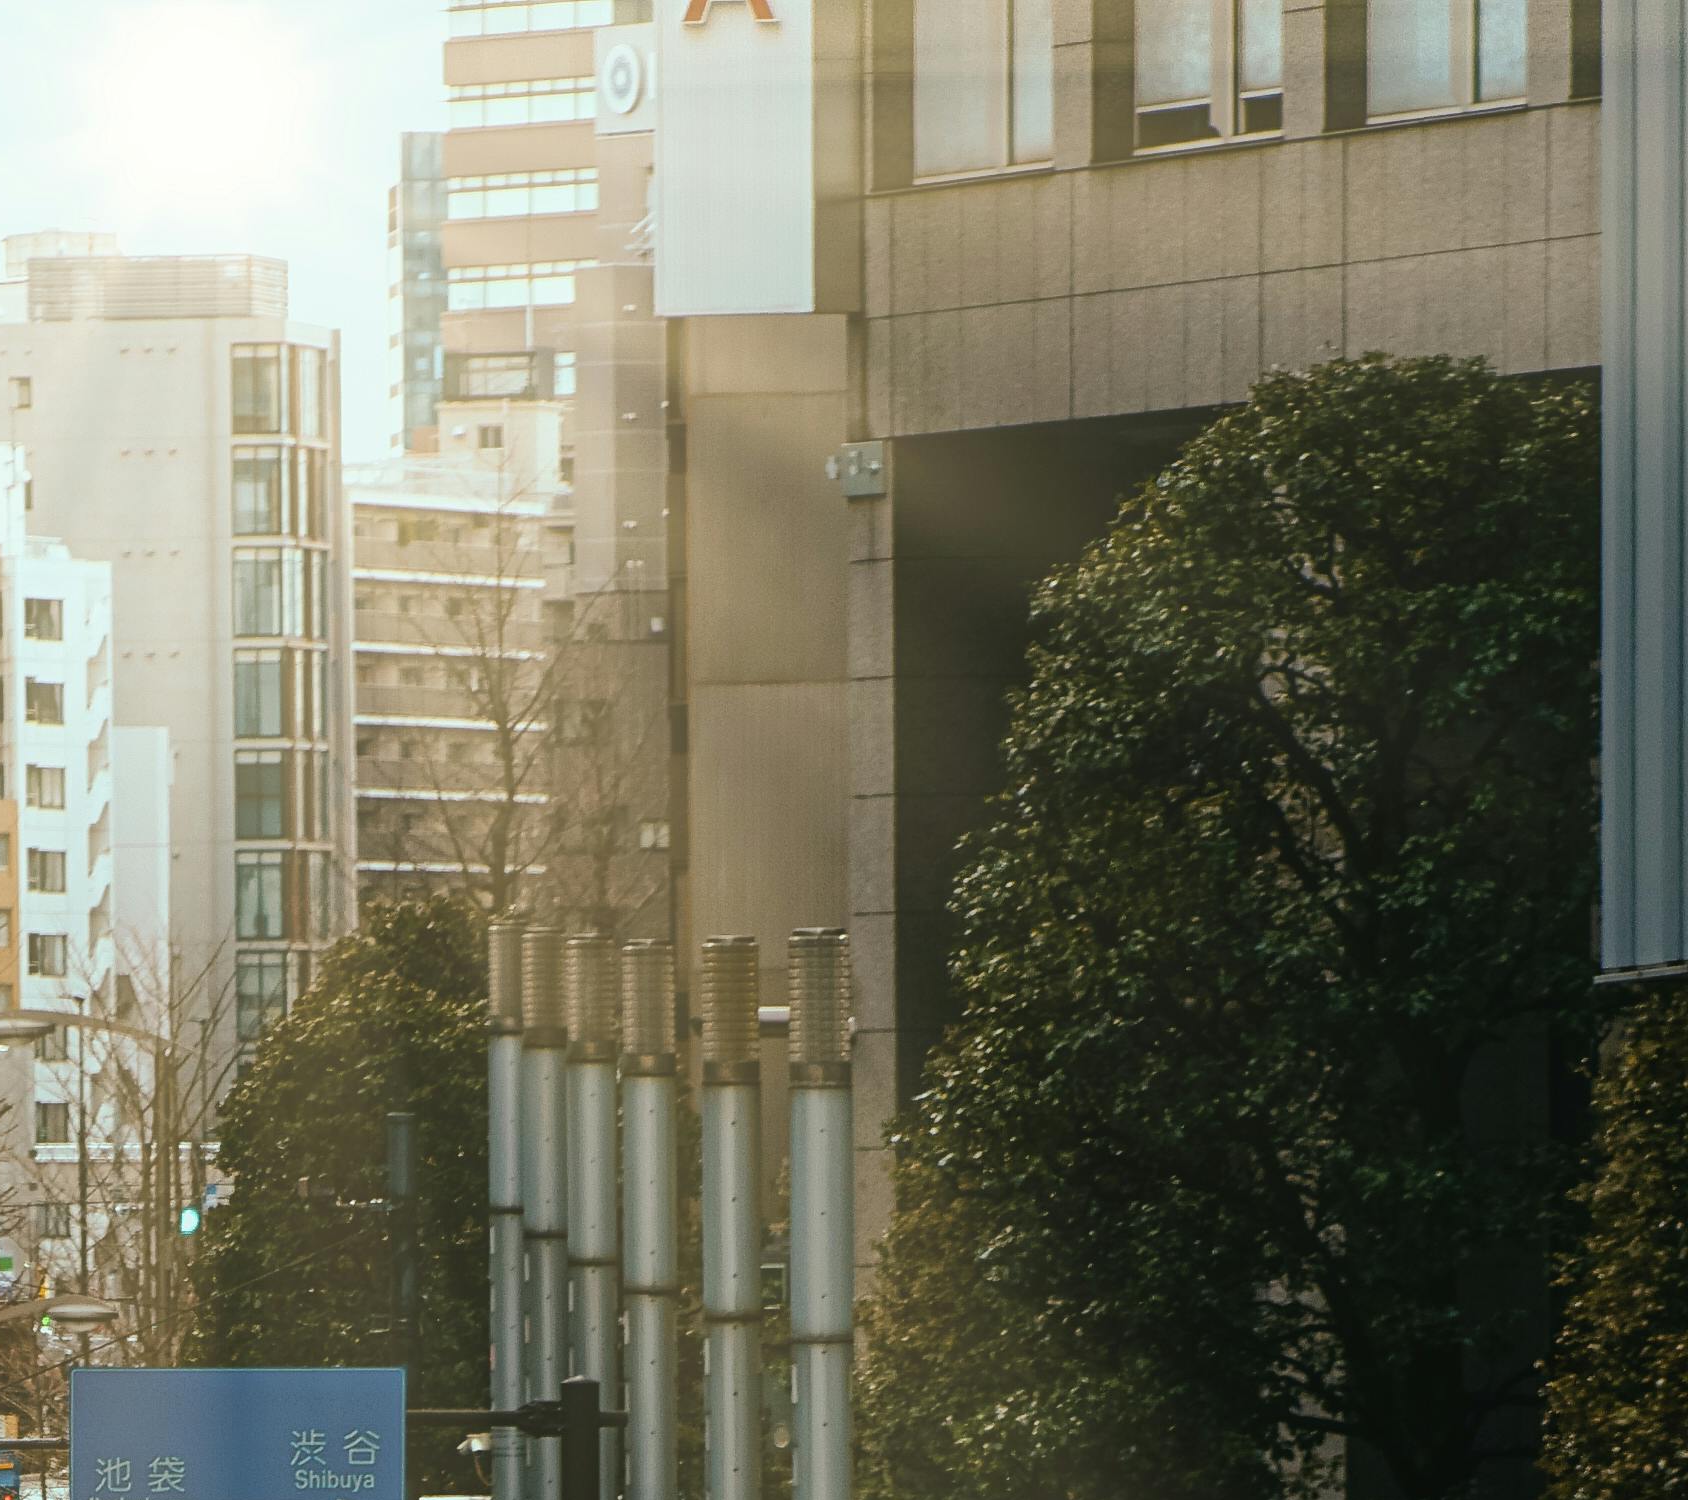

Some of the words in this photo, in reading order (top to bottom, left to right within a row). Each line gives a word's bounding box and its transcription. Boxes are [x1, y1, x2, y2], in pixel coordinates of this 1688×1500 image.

[289, 1428, 382, 1466] 渋谷
[94, 1456, 186, 1493] 池袋
[294, 1469, 376, 1493] Shibuya
